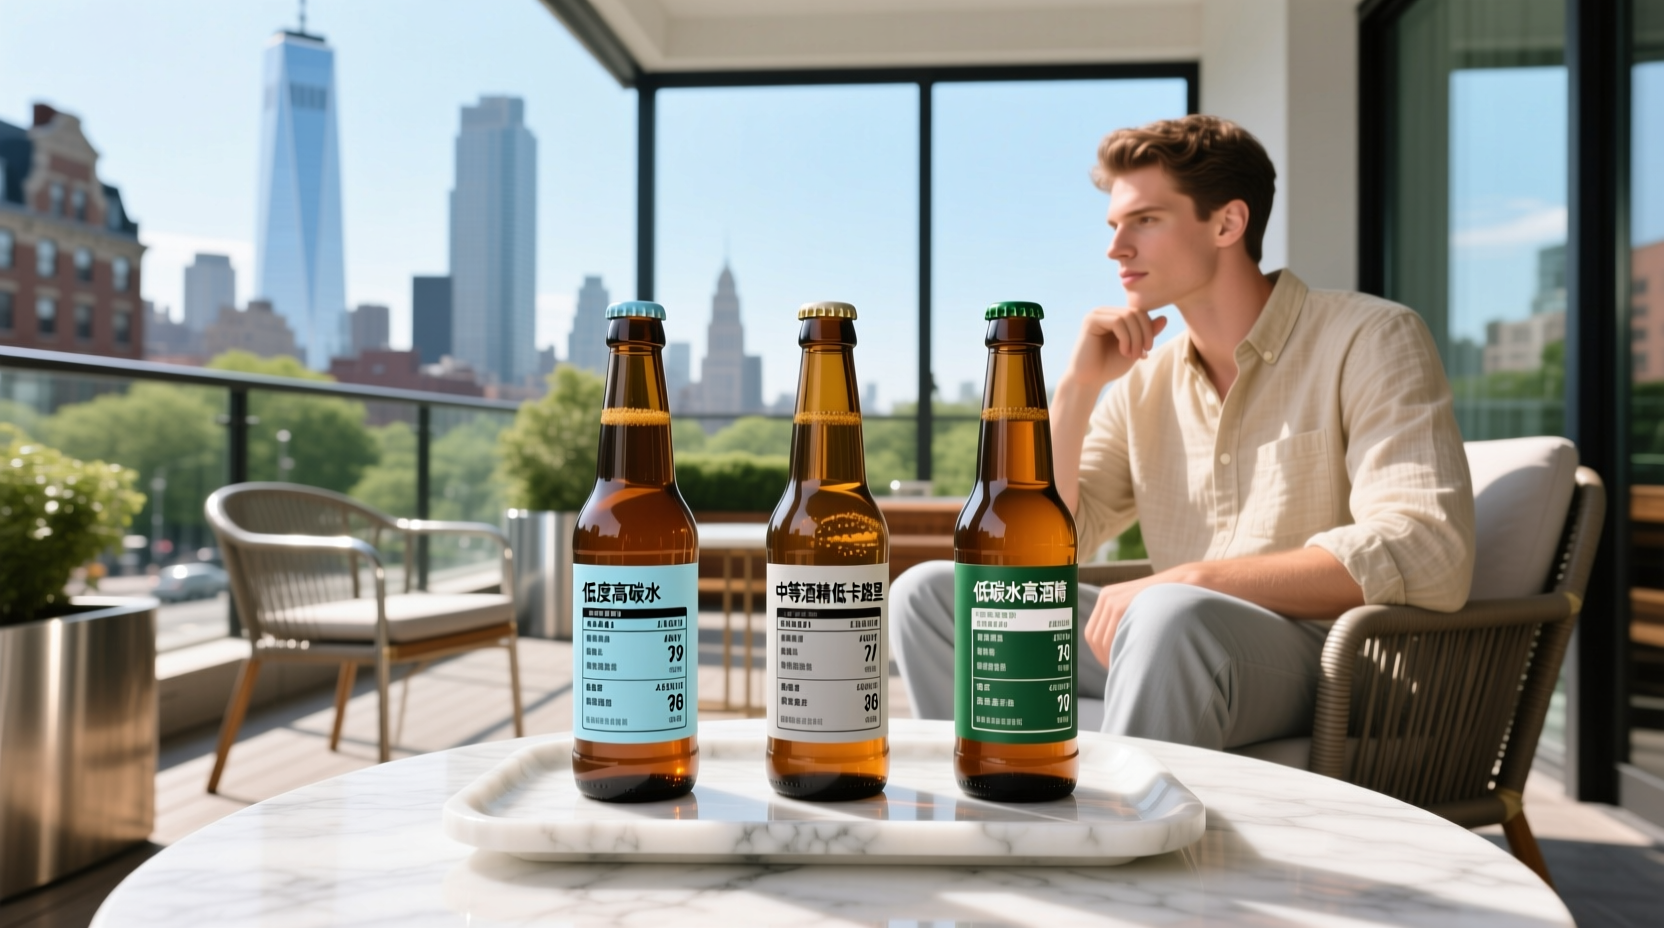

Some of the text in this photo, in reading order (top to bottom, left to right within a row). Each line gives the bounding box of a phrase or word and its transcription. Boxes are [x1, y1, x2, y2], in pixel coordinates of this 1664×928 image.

[582, 581, 661, 604] 低度高碳水
